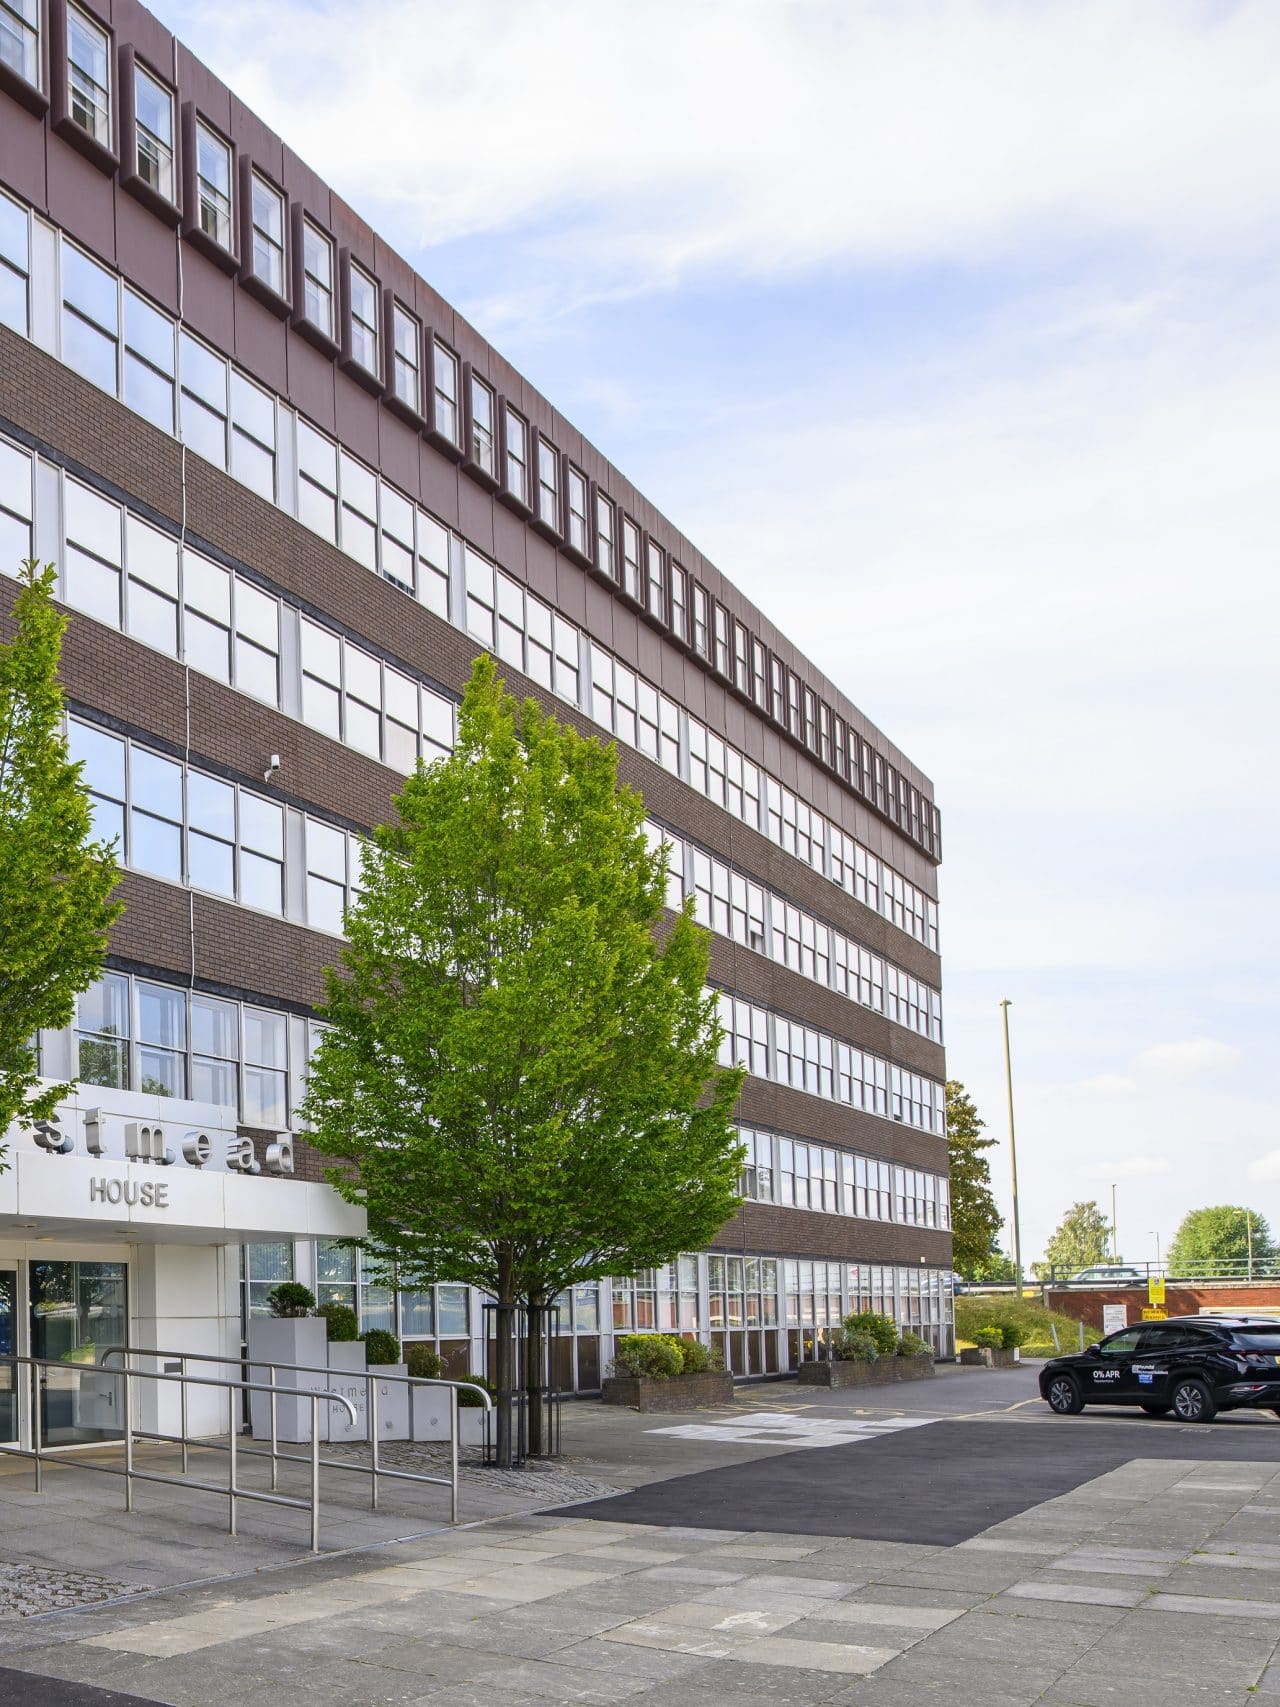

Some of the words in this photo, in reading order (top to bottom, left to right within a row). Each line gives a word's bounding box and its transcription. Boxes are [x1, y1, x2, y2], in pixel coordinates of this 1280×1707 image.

[33, 1107, 294, 1174] stmead
[90, 1176, 169, 1208] HOUSE
[1093, 1370, 1105, 1379] 0%
[1105, 1370, 1121, 1379] APR
[332, 1403, 365, 1413] HOSE
